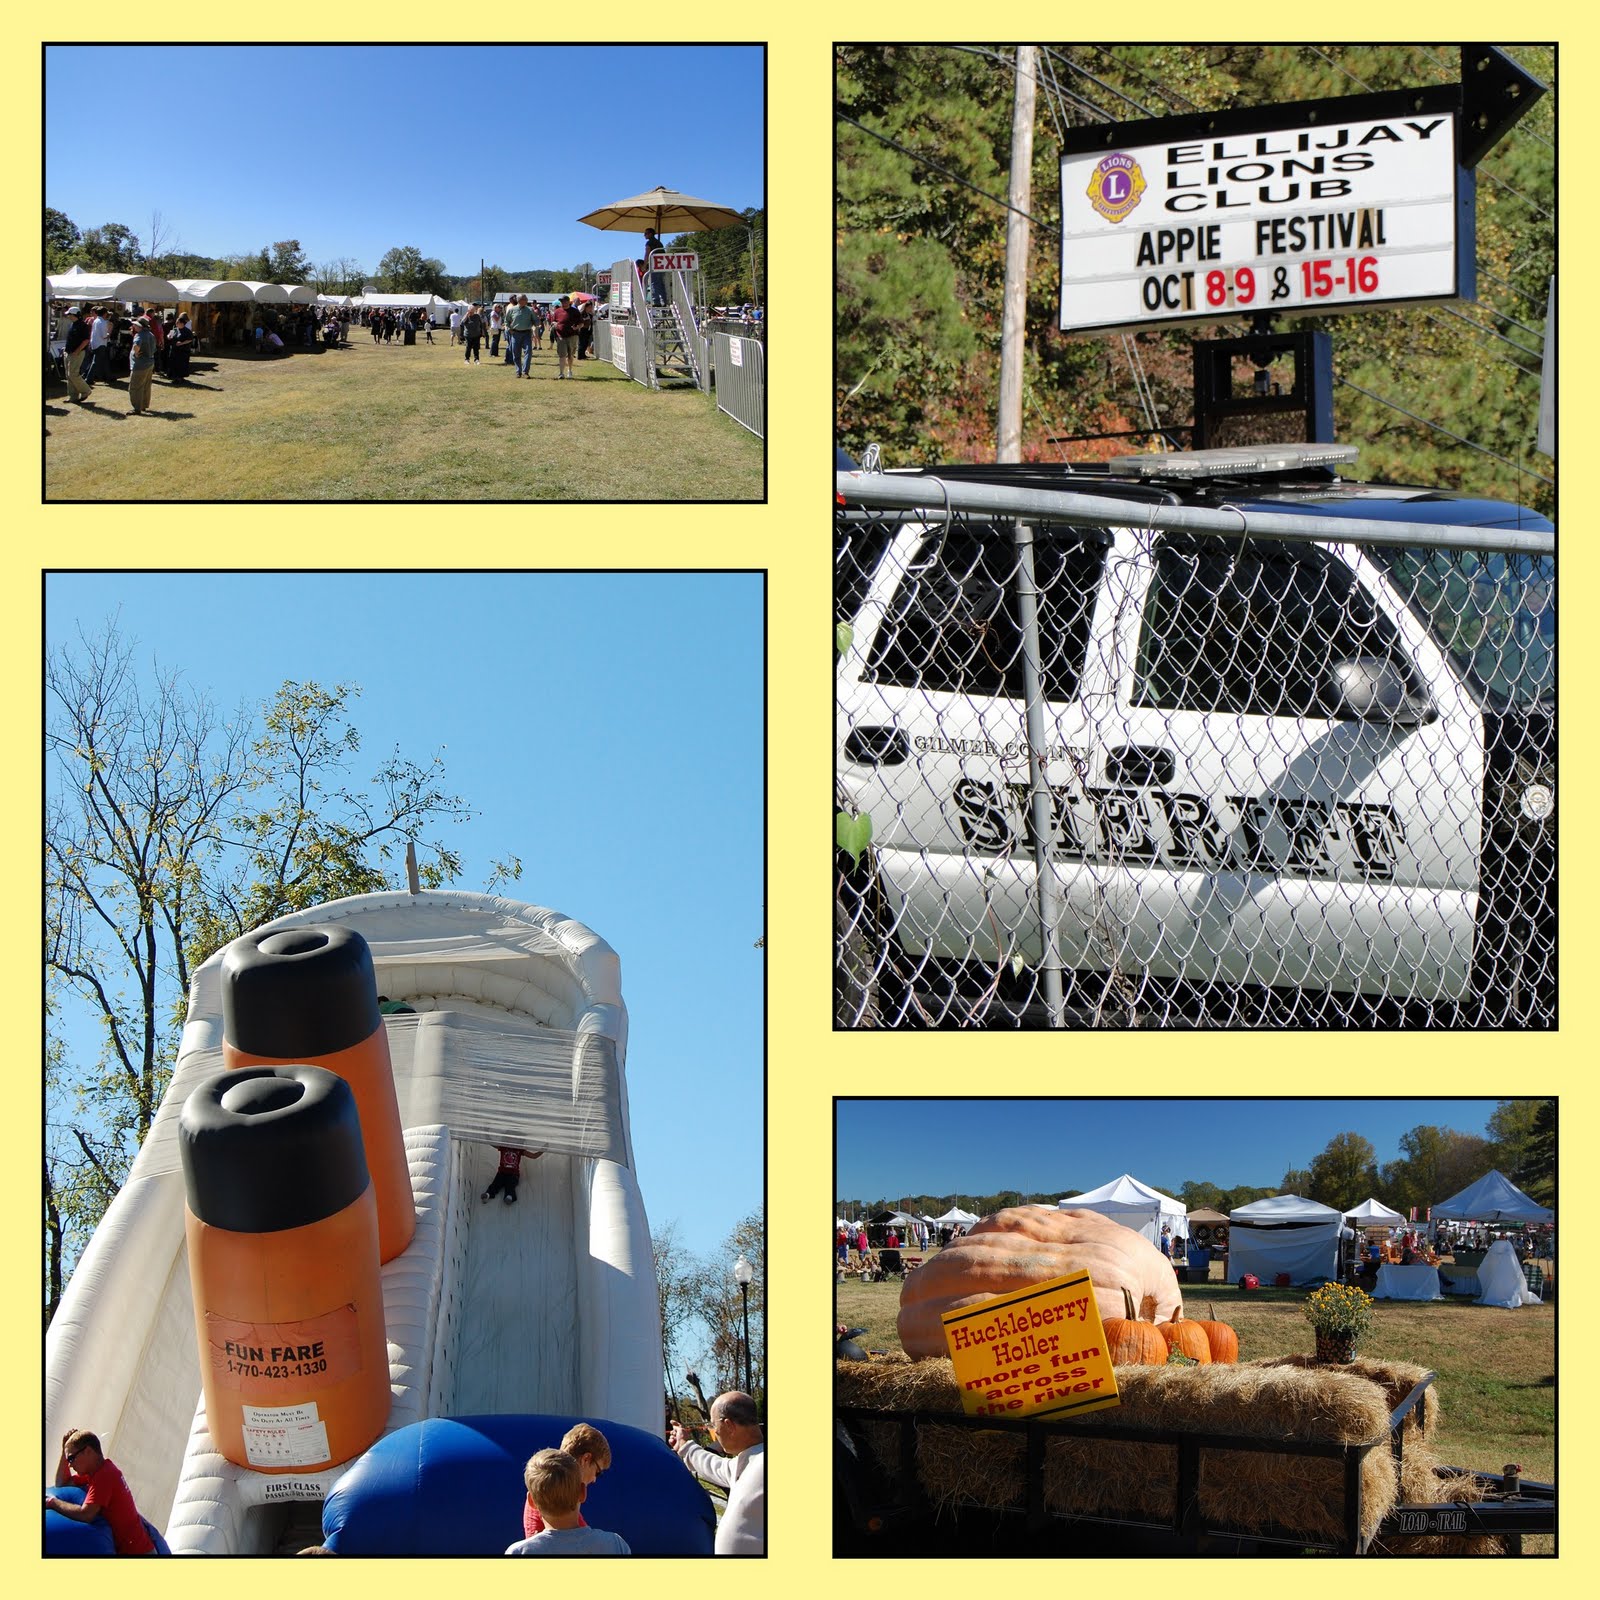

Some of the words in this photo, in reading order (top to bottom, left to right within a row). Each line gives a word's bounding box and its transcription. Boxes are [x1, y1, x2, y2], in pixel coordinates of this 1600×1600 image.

[1167, 119, 1447, 166] ELLIJAY
[1101, 157, 1133, 171] LIONS
[1166, 152, 1375, 190] LIONS
[1108, 174, 1126, 199] L
[1164, 179, 1353, 213] CLUB
[1136, 225, 1221, 267] APPLE
[1256, 209, 1386, 256] FESTIVAL
[653, 255, 695, 270] EXIT
[1143, 272, 1196, 311] OCT
[1206, 267, 1257, 307] 8-9
[1301, 256, 1380, 298] 15-16
[914, 735, 998, 757] GILMER
[1003, 742, 1095, 763] CONTY
[953, 777, 1408, 880] SHERIFF
[951, 1296, 1089, 1350] Huckleberry
[225, 1340, 264, 1362] FUN
[271, 1341, 325, 1363] FARE
[992, 1334, 1060, 1366] Holler
[227, 1359, 328, 1379] 1-770-423-1330
[965, 1363, 1041, 1391] more
[1050, 1347, 1100, 1368] fun
[985, 1366, 1088, 1400] across
[976, 1399, 1024, 1416] the
[1034, 1377, 1104, 1403] river
[265, 1481, 292, 1492] FIRST
[294, 1482, 321, 1491] CLASS
[1401, 1512, 1428, 1532] LOAD
[1437, 1511, 1466, 1532] TRAIL
